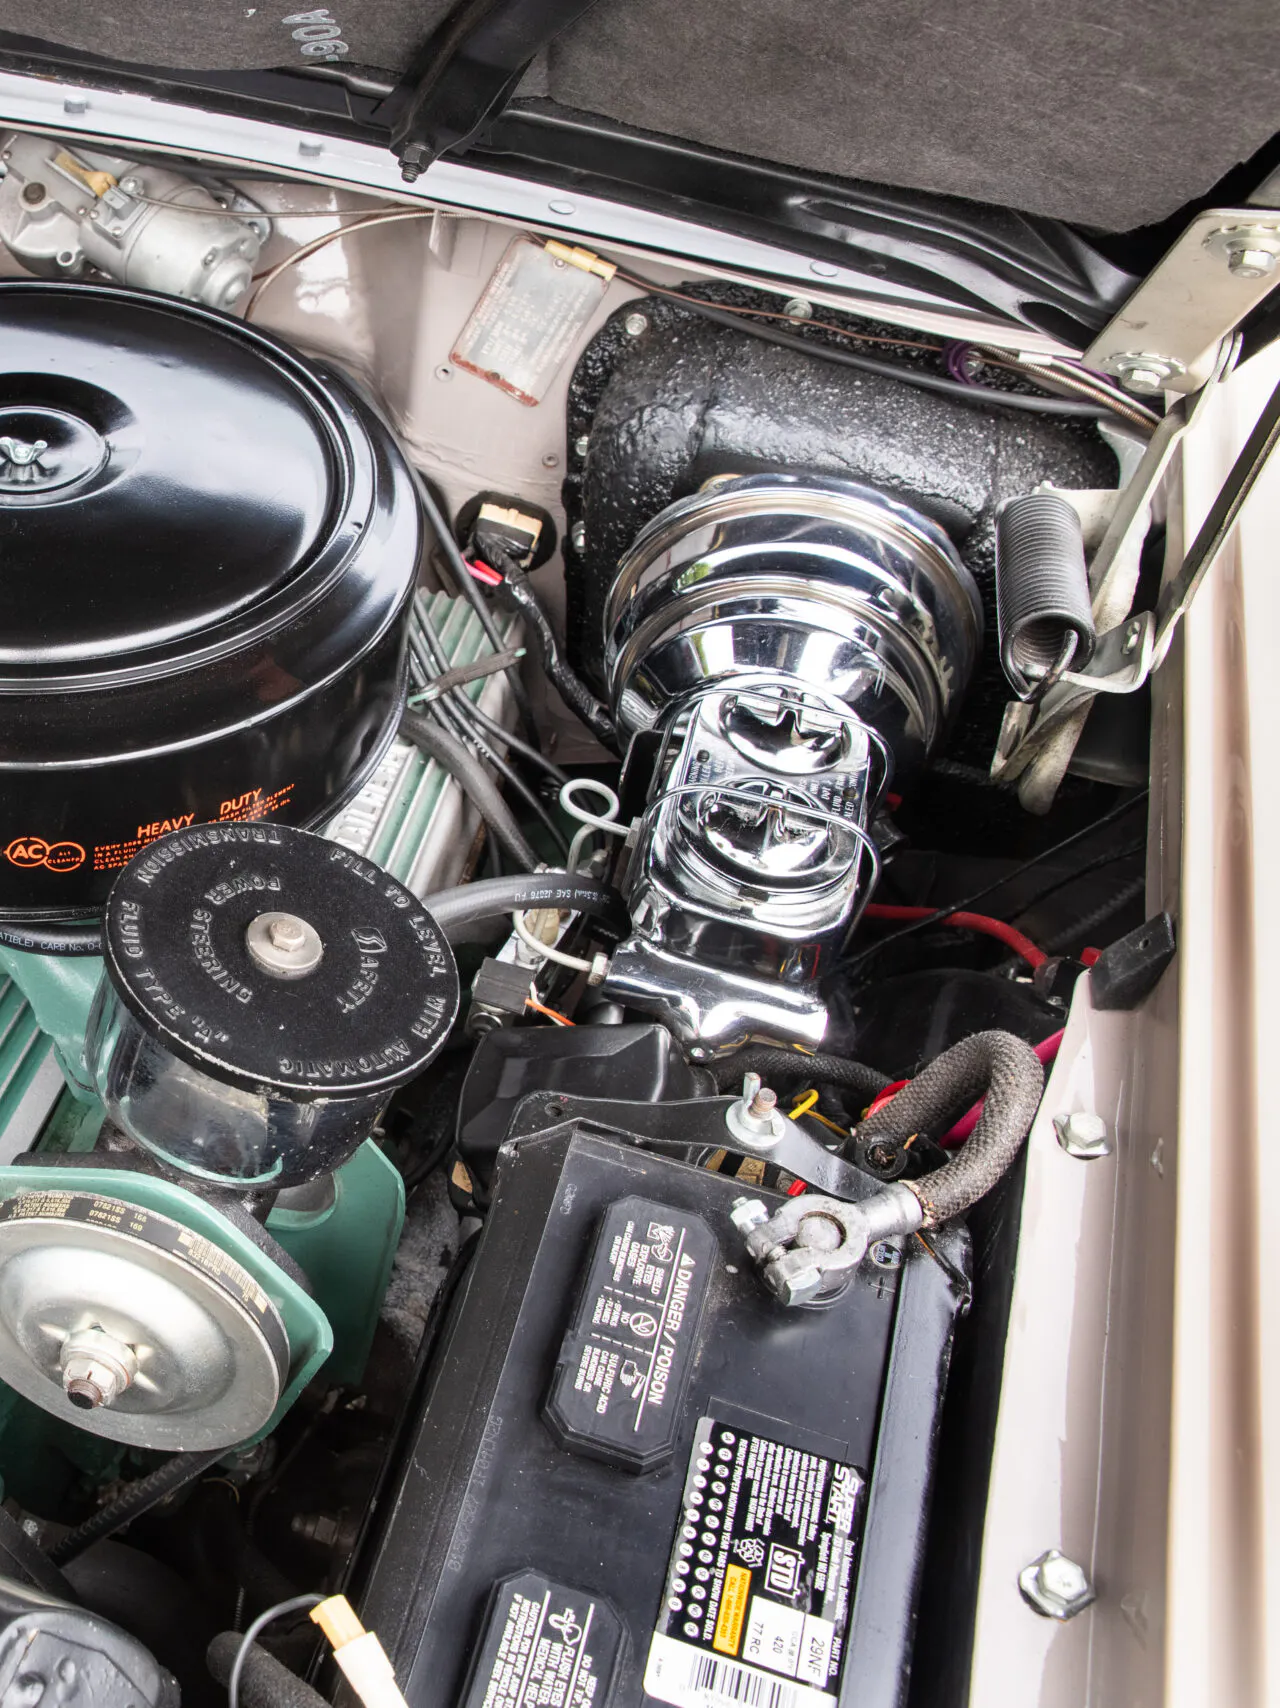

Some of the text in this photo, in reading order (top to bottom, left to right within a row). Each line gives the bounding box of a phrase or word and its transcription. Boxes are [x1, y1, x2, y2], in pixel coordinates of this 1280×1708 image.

[137, 788, 262, 838] HEAVY DUTY
[12, 844, 42, 859] AC
[137, 828, 282, 884] TRANSMISSION
[329, 849, 377, 886] FILL
[385, 884, 411, 909] TO
[40, 942, 65, 950] CARB
[120, 900, 145, 959] FLUID
[191, 875, 282, 1004] POWER STEERING
[408, 915, 447, 979] LEVEL
[135, 968, 187, 1021] TYPE
[411, 995, 447, 1040] WITH
[279, 1038, 411, 1077] AUTOMATIC
[625, 1240, 640, 1268] GASES
[630, 1243, 649, 1286] EXPLOSIVE
[641, 1263, 655, 1285] EYES
[649, 1266, 664, 1295] SHIELD
[591, 1296, 605, 1324] SMOKING
[600, 1299, 613, 1323] FLAMES
[608, 1302, 621, 1327] SPARKS
[619, 1310, 630, 1324] NO
[646, 1268, 692, 1405] DANGER / POISON
[573, 1344, 592, 1390] SEVERE BURNS
[582, 1347, 600, 1393] BLINDNESS OR
[592, 1349, 609, 1387] CAN CAUSE
[595, 1352, 618, 1414] SULFURIC ACID
[823, 1463, 851, 1526] START
[838, 1474, 861, 1534] SUPER
[702, 1438, 748, 1641] REMOVE PROPER MONTH AND YEAR TABS TO SHOW DATE SOLD.
[815, 1531, 833, 1562] Springfield
[767, 1550, 796, 1590] STD
[490, 1592, 522, 1680] IF NOT AVAILABLE SEEK
[497, 1597, 531, 1696] INSTRUCTIONS IN VEHICLE
[518, 1636, 531, 1654] FOR
[749, 1621, 764, 1654] 77 RC
[771, 1635, 784, 1654] 420
[806, 1636, 825, 1677] 29NF
[828, 1636, 841, 1677] PART NO.
[512, 1653, 527, 1675] SAFE
[530, 1636, 551, 1681] MEDICAL
[535, 1641, 563, 1707] WITH WATER.
[548, 1645, 575, 1708] FLUSH EYES
[506, 1674, 521, 1697] JUMP
[571, 1654, 593, 1705] DO NOT TIP.
[583, 1675, 598, 1698] KEEP
